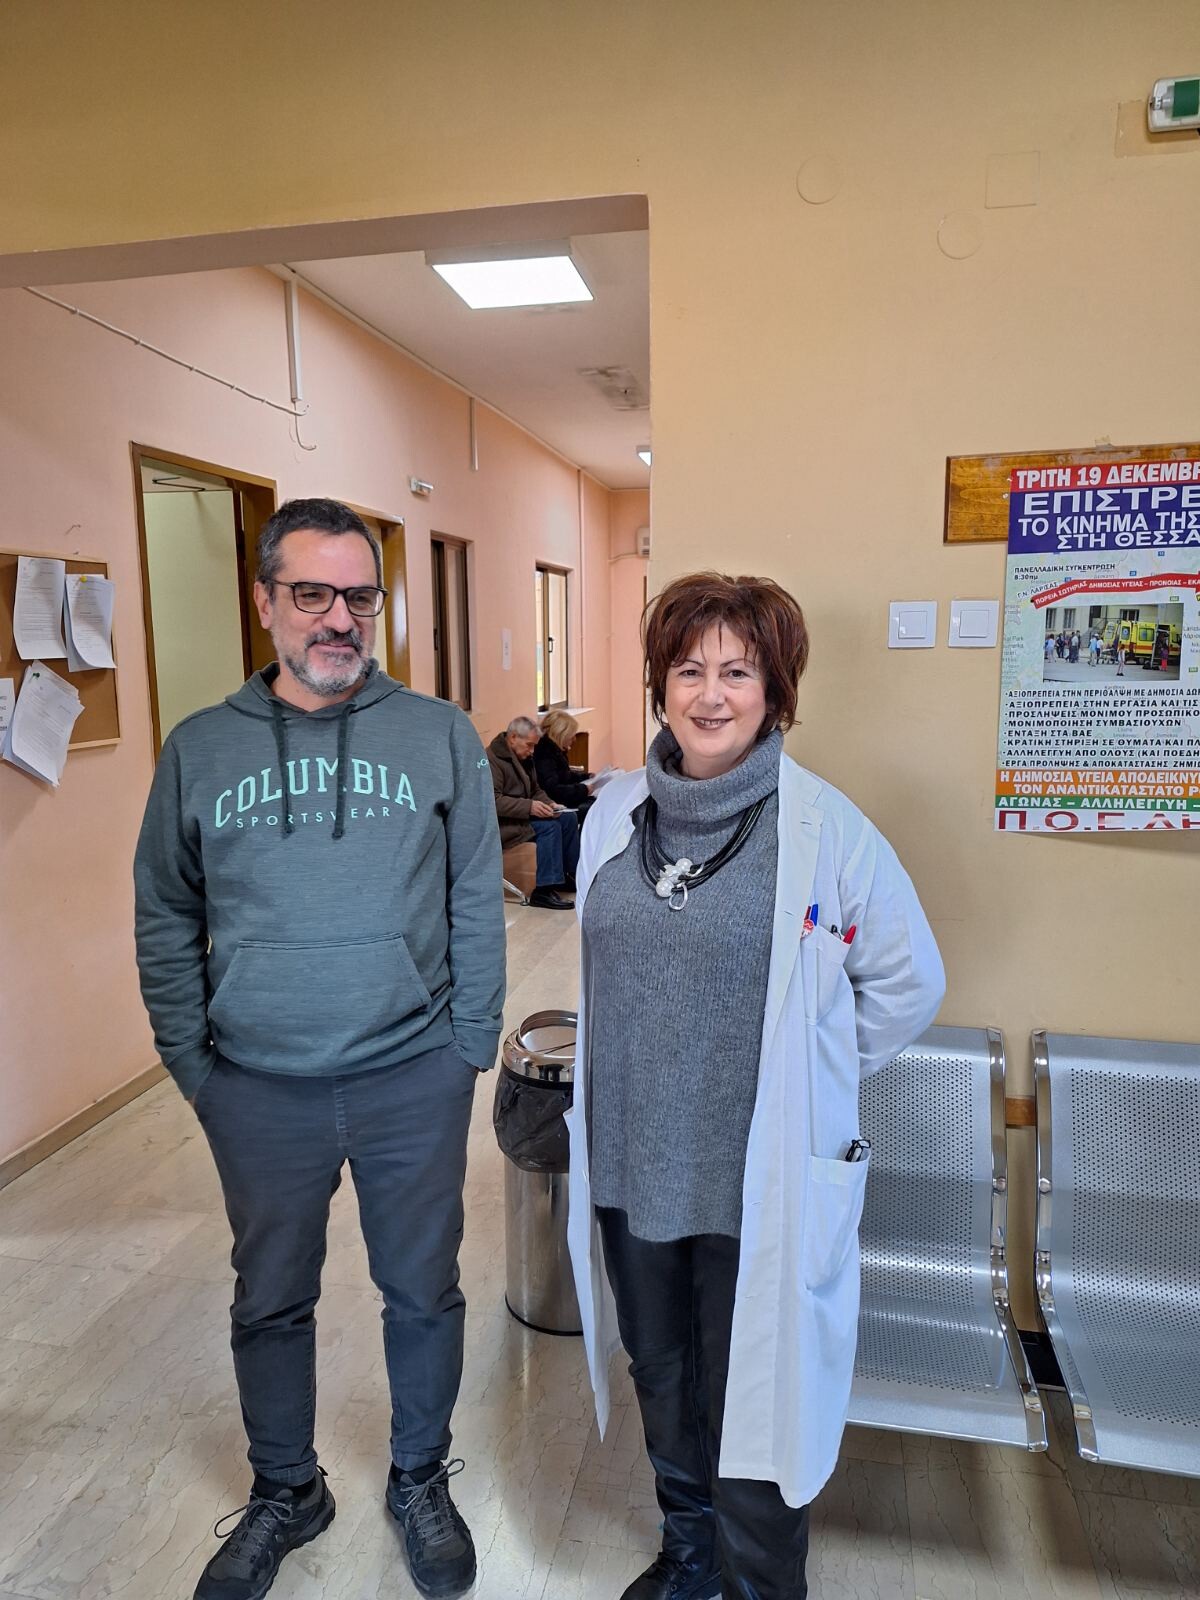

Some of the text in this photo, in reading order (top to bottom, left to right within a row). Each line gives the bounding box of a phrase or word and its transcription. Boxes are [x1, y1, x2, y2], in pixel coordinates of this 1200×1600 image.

[1016, 468, 1071, 489] ΤΡΙΤΗ
[1077, 466, 1101, 486] 19
[1024, 485, 1200, 515] ΕΠΙΣΤΡΕ
[1018, 511, 1200, 536] ΤΟ ΚΙΝΗΜΑ ΤΗΣ
[1057, 529, 1200, 549] ΣΤΗ ΘΕΣΣΑ
[1065, 564, 1115, 572] ΣΥΓΚΕΝΤΡΩΣΗ
[1084, 689, 1132, 697] ΠΕΡΙΘΑΛΨΗ
[1096, 719, 1181, 727] ΣΥΜΒΑΣΙΟΥΧΩΝ
[1138, 749, 1160, 758] (ΚΑΙ
[1000, 771, 1200, 784] Η ΔΗΜΟΣΙΑ ΥΓΕΙΑ ΑΠΟΔΕΙΚΝΥ
[215, 757, 417, 828] COLUMBIA
[1013, 784, 1042, 794] ΤΟΝ
[1046, 784, 1184, 796] ΑΝΑΝΤΙΚΑΤΑΣΤΑΤΟ
[998, 796, 1062, 807] ΑΓΩΝΑΣ
[1080, 797, 1187, 810] ΑΛΛΗΛΕΓΓΥΗ
